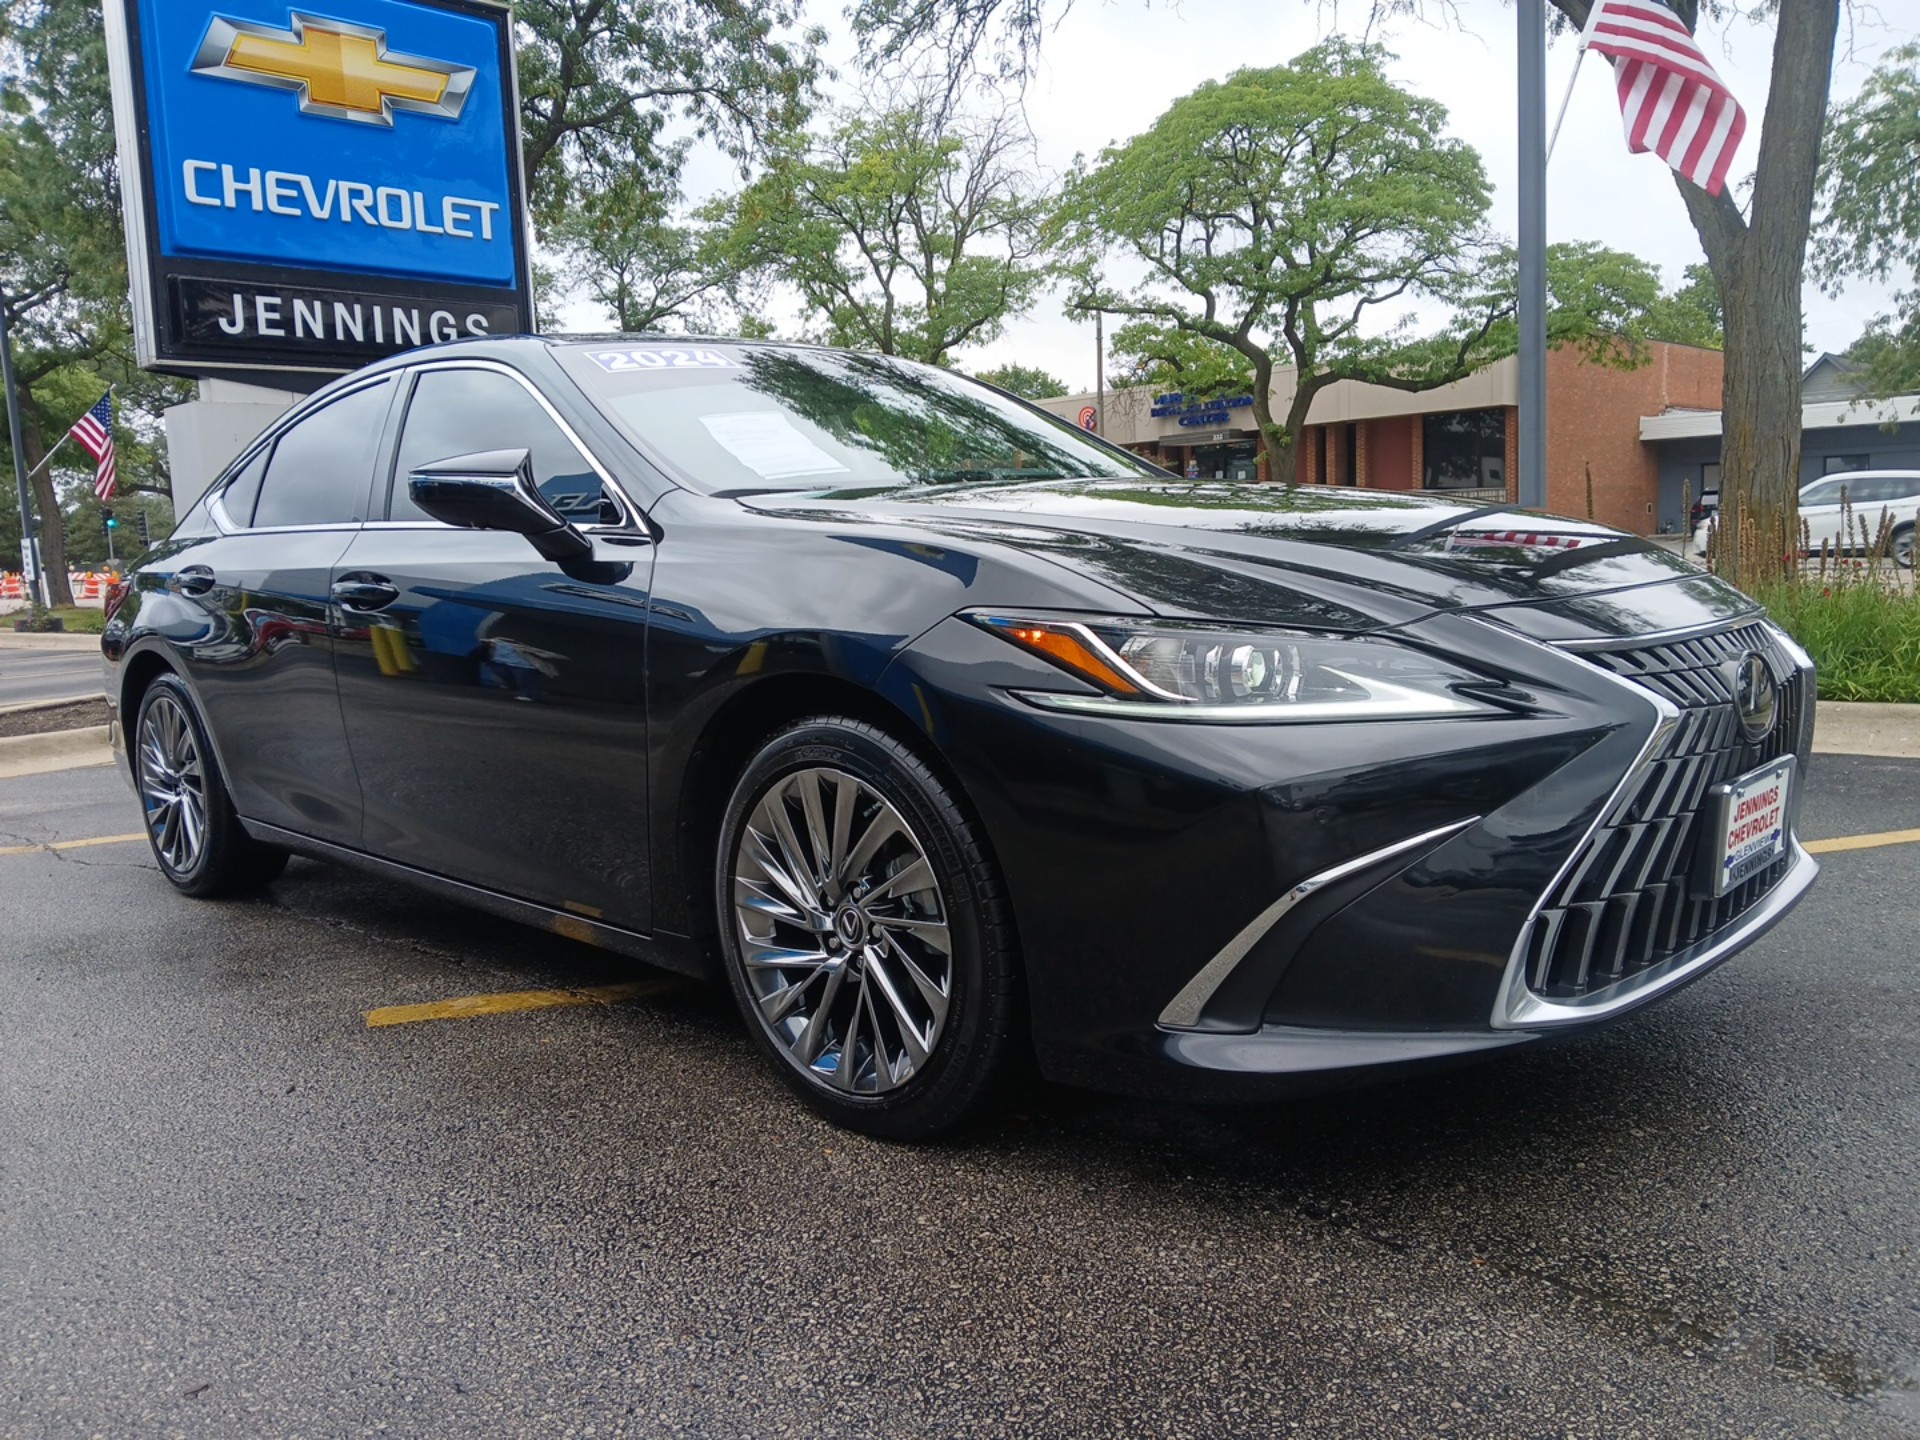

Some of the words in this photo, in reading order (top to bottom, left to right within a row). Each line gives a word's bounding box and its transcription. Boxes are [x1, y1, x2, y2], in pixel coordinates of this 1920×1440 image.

[182, 159, 499, 240] CHEVROLET
[218, 293, 490, 345] JENNINGS
[598, 348, 728, 370] 2024
[1733, 784, 1780, 823] JENNINGS
[1727, 806, 1780, 850] CHEVROLET
[1734, 833, 1772, 862] GLENVIEW
